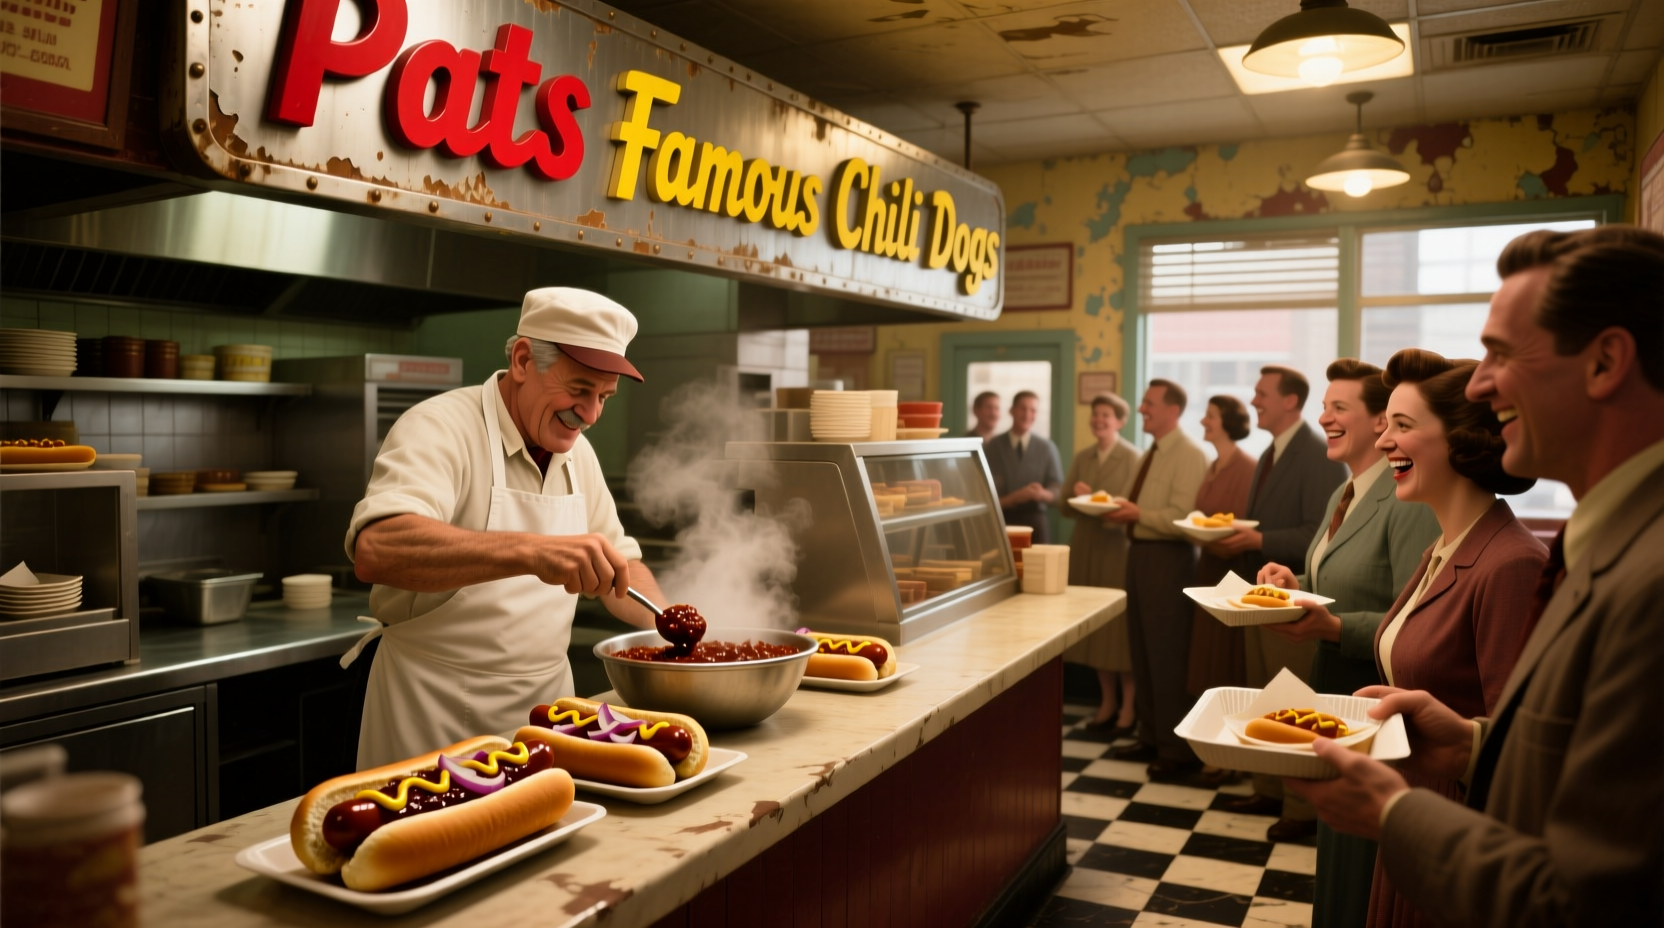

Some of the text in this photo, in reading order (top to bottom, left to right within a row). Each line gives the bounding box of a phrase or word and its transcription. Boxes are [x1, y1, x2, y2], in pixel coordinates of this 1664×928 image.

[269, 0, 1000, 296] Pats Famous Chili Dogs
